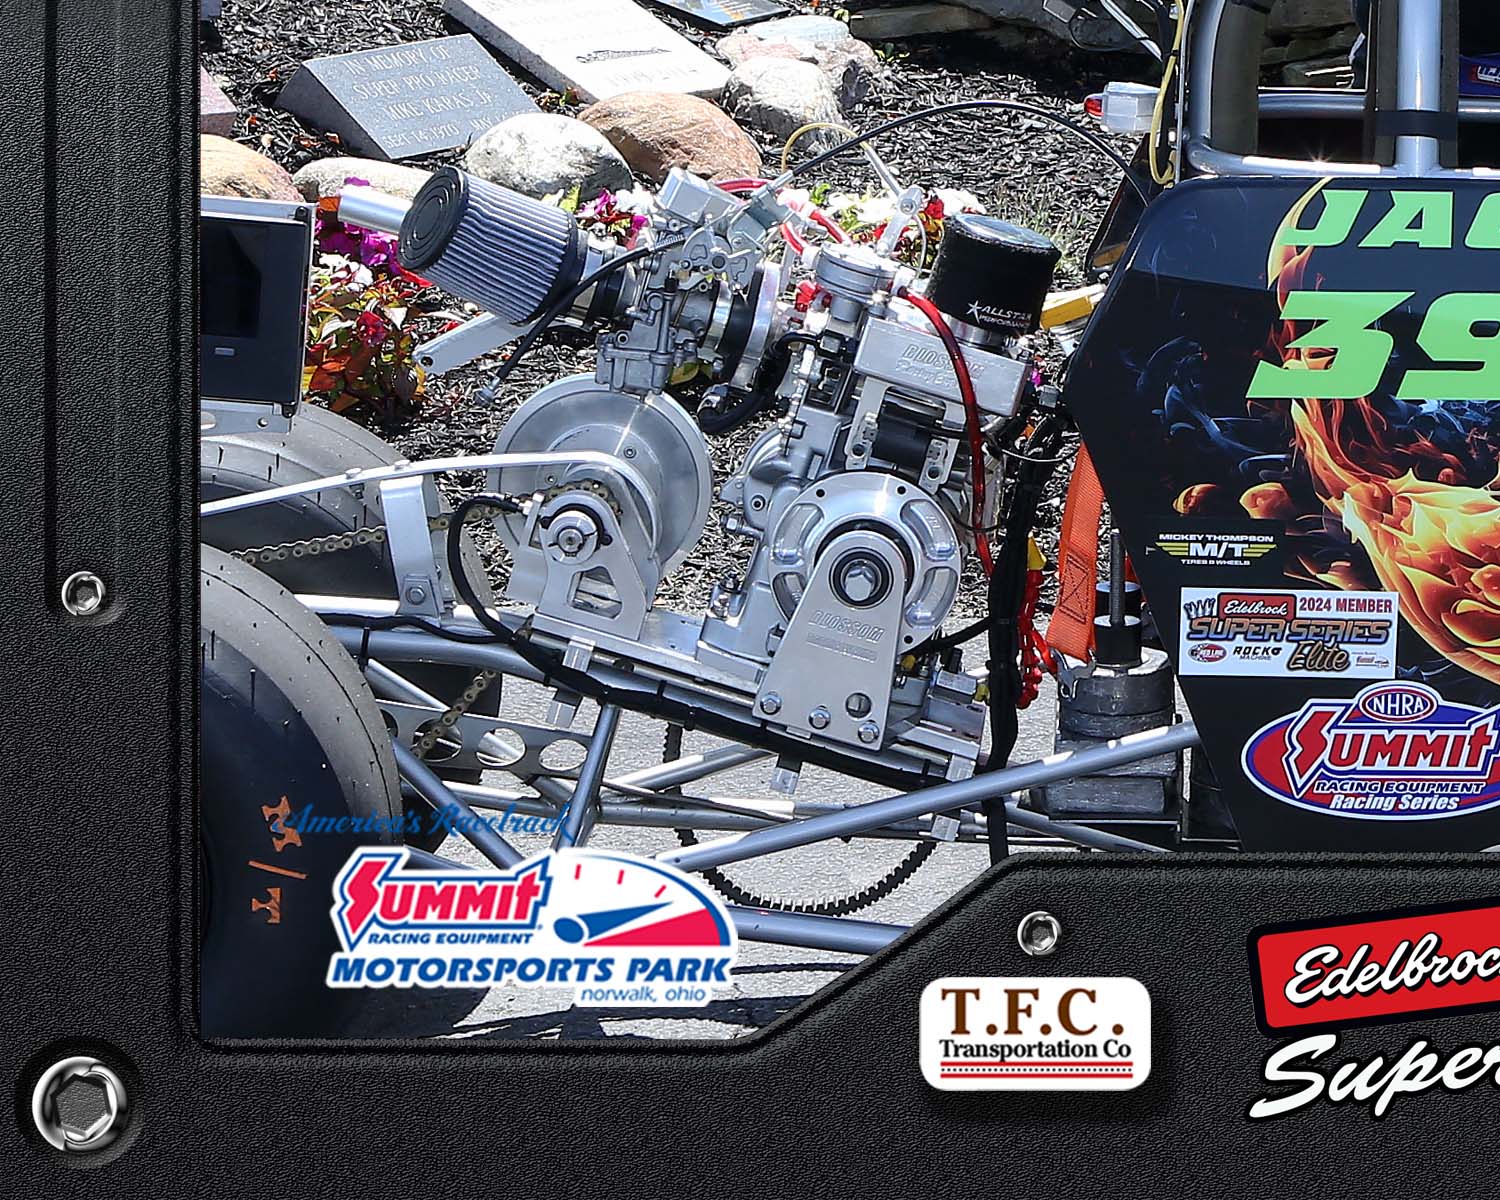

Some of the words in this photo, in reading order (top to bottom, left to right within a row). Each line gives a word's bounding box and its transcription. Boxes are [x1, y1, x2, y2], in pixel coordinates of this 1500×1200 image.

[343, 59, 362, 75] IN
[366, 48, 426, 74] MEMORY
[430, 45, 452, 63] OF
[352, 78, 401, 101] SUPER
[402, 75, 435, 92] PRO
[437, 65, 482, 87] RACER
[383, 102, 425, 122] MIKE
[424, 92, 475, 115] KARAS
[981, 305, 1033, 320] ALLSTAR
[1159, 533, 1203, 542] MICKEY
[1206, 534, 1274, 543] THOMPSON
[1189, 542, 1250, 558] M/T
[1224, 600, 1288, 616] Edelbrock
[1299, 598, 1331, 612] 2024
[1335, 598, 1393, 613] MEMBER
[1187, 618, 1285, 642] SUPER
[1286, 619, 1393, 645] SERIES
[1287, 640, 1349, 672] Elite
[1371, 693, 1426, 717] NHRA
[1313, 780, 1380, 793] RACING
[1383, 780, 1486, 794] EQUIPMENT
[1329, 794, 1396, 812] Racing
[1398, 794, 1460, 811] Series
